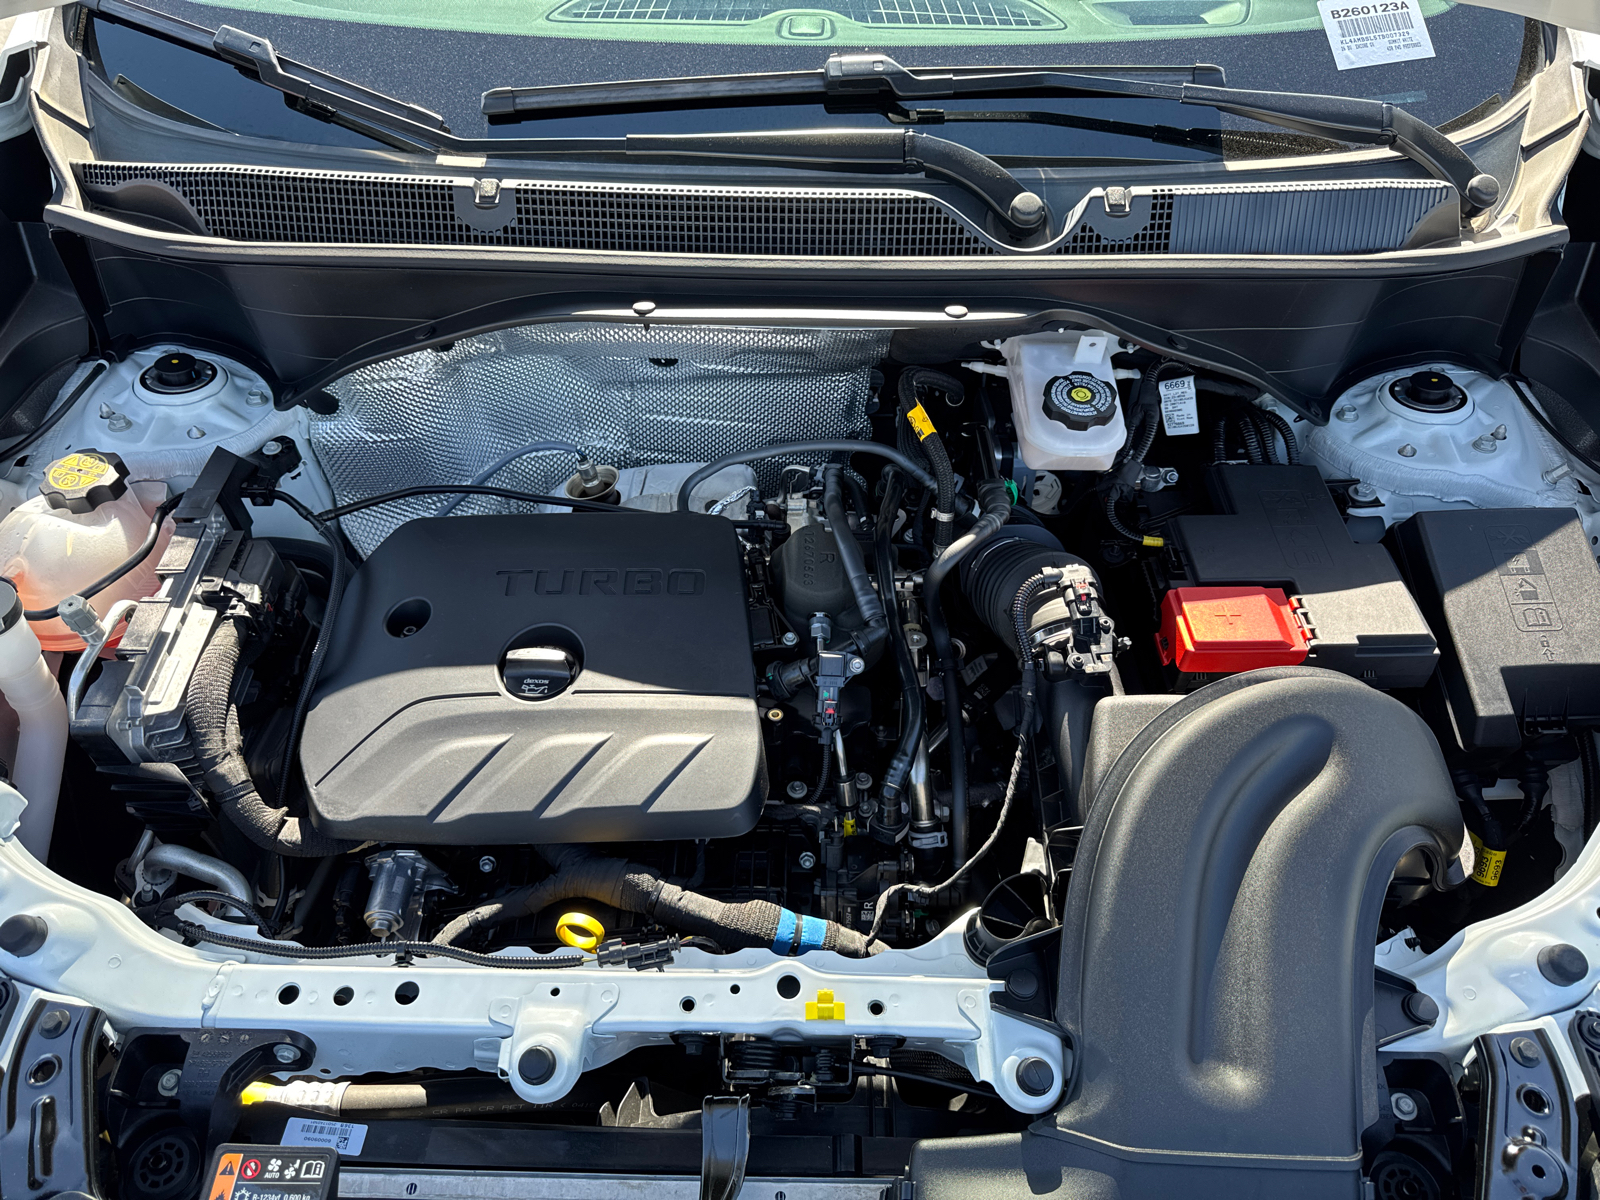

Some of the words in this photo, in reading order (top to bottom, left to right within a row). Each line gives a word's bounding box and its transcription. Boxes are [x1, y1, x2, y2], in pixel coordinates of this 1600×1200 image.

[1331, 1, 1409, 19] B260123A
[1165, 380, 1185, 390] 6669
[804, 532, 815, 586] 12670563
[820, 552, 836, 564] R
[496, 568, 707, 597] TURBO
[523, 677, 550, 685] dexos
[1476, 856, 1488, 878] 9693
[1491, 860, 1502, 880] 9693
